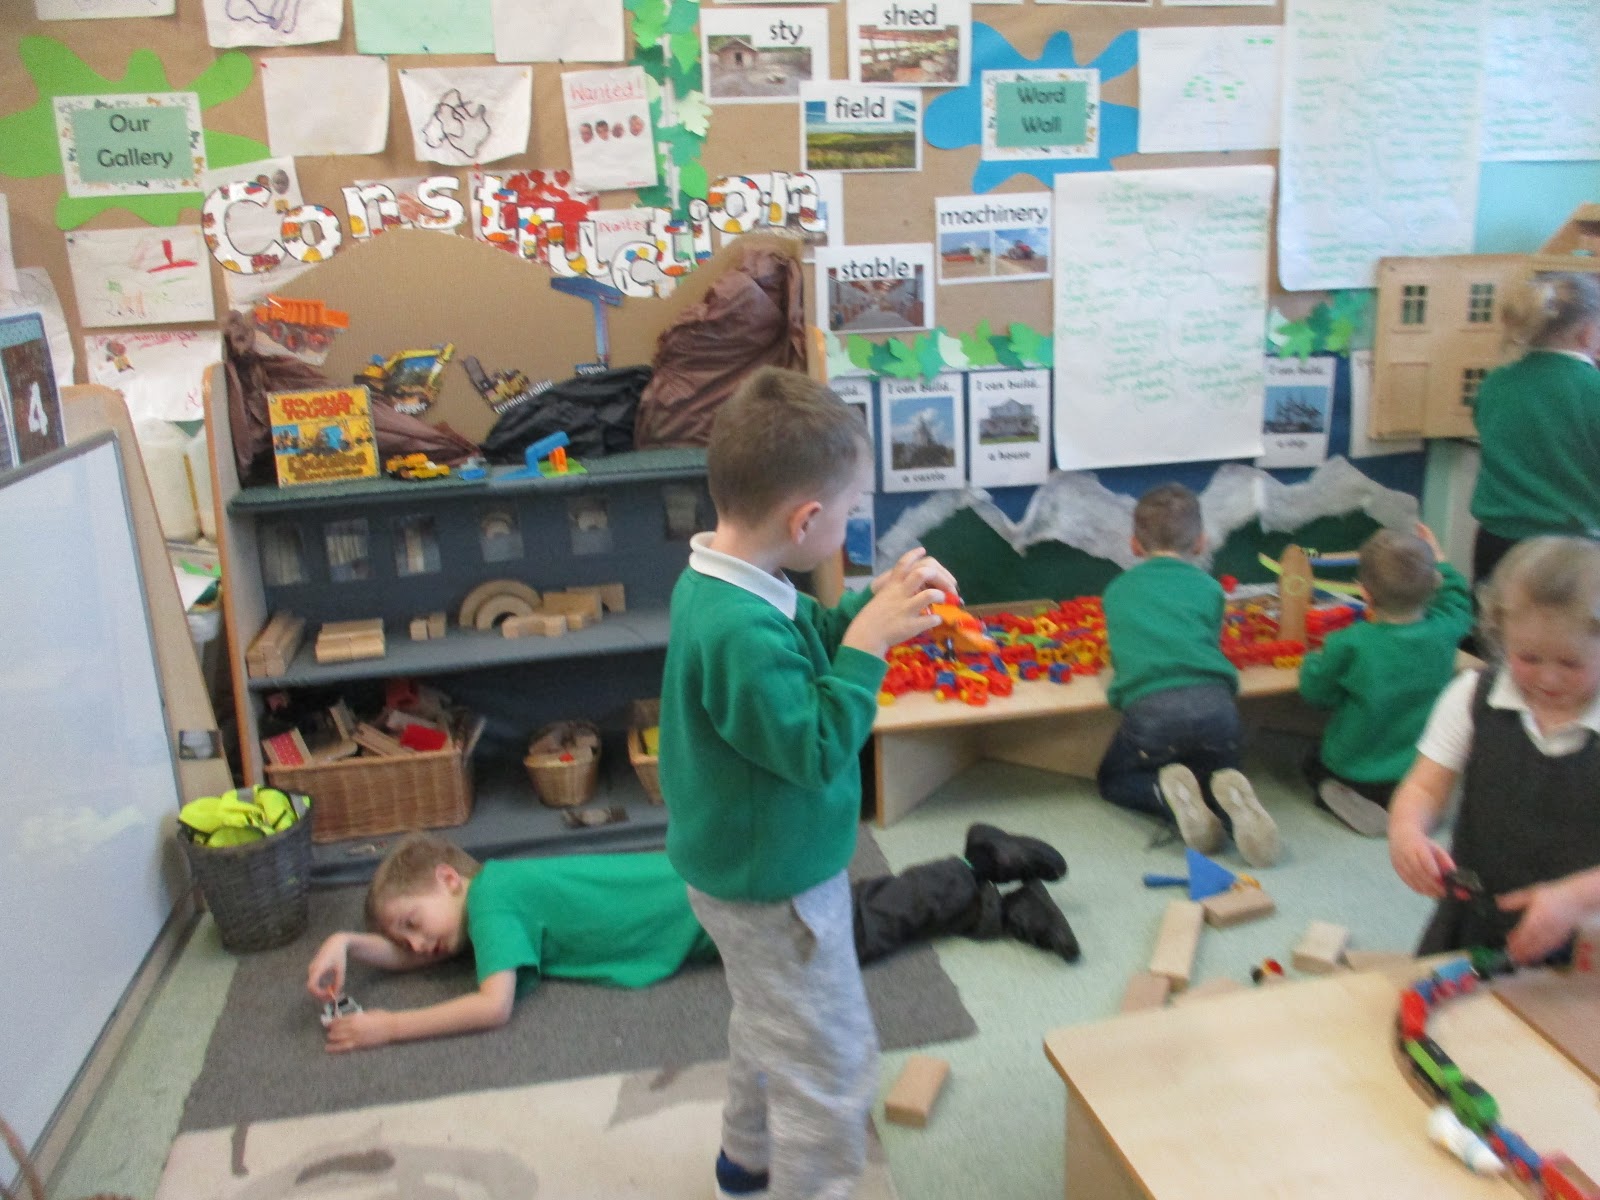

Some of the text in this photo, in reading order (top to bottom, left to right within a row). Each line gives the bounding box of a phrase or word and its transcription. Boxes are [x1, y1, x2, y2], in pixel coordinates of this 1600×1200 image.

[883, 4, 938, 26] shed
[770, 20, 803, 44] sty
[1017, 86, 1066, 104] Word
[835, 96, 885, 119] field
[109, 113, 151, 133] Our
[1021, 116, 1062, 133] Wall
[96, 147, 174, 169] Gallery
[939, 204, 1047, 226] machinery
[202, 171, 827, 298] Construction
[842, 257, 911, 279] stable
[28, 381, 49, 436] 4
